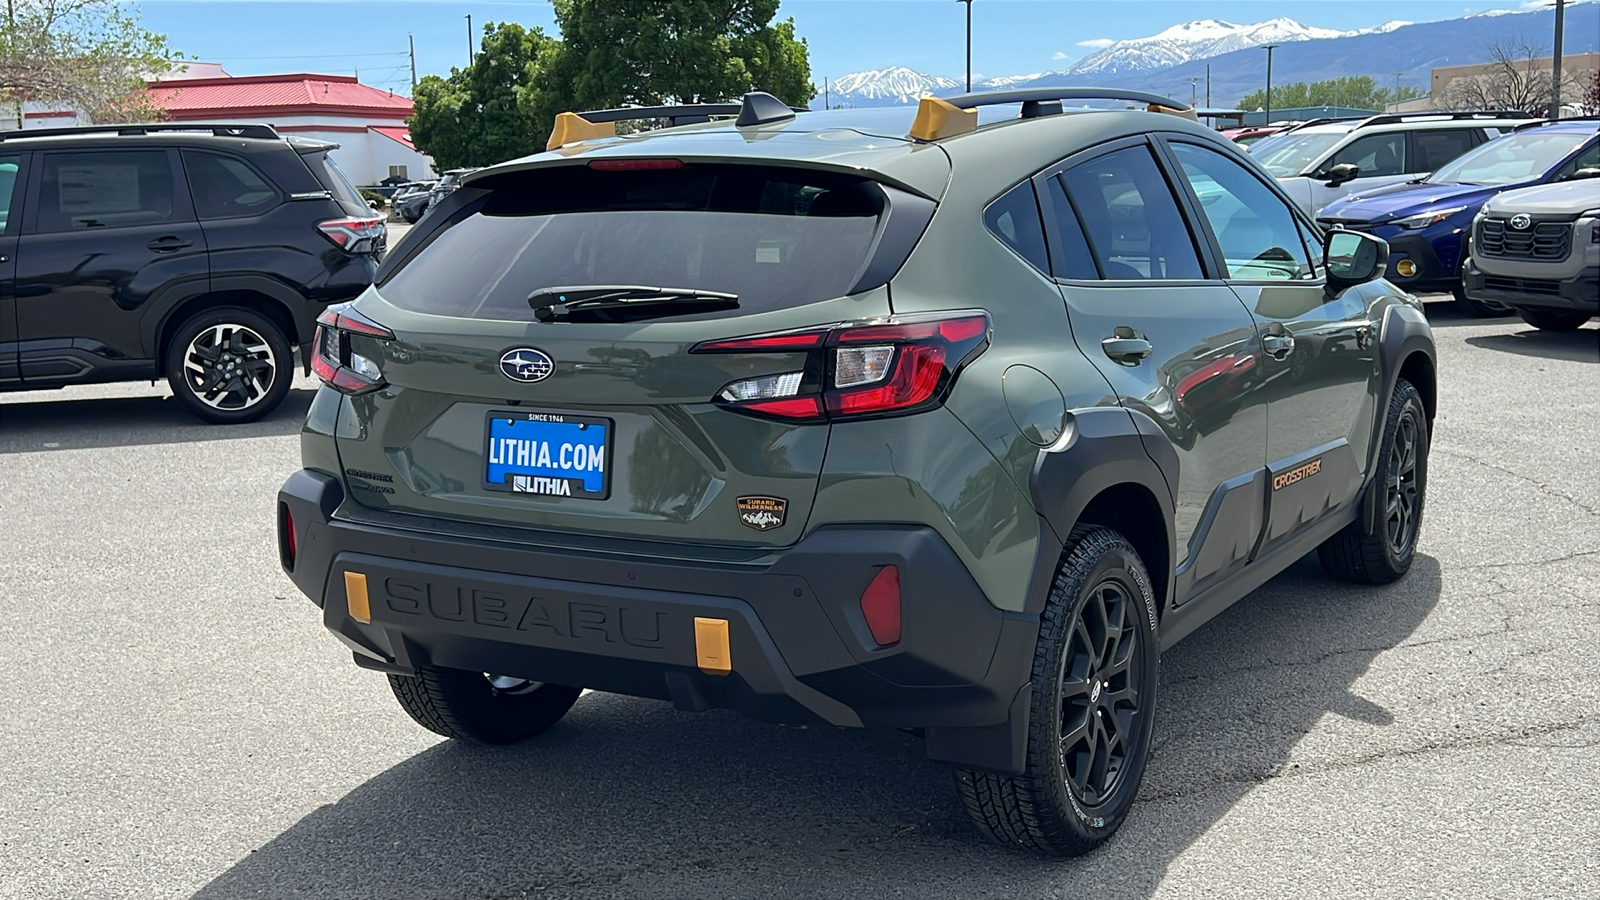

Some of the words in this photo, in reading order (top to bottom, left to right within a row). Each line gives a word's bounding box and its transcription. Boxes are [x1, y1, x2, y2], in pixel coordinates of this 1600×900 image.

[528, 413, 548, 422] SINCE
[549, 415, 564, 423] 1946
[489, 437, 605, 473] LITHIA.COM
[526, 476, 571, 496] LITHIA
[1273, 459, 1321, 490] CROSSTREK
[739, 503, 784, 511] WILDERNESS
[384, 576, 668, 649] SUBARU
